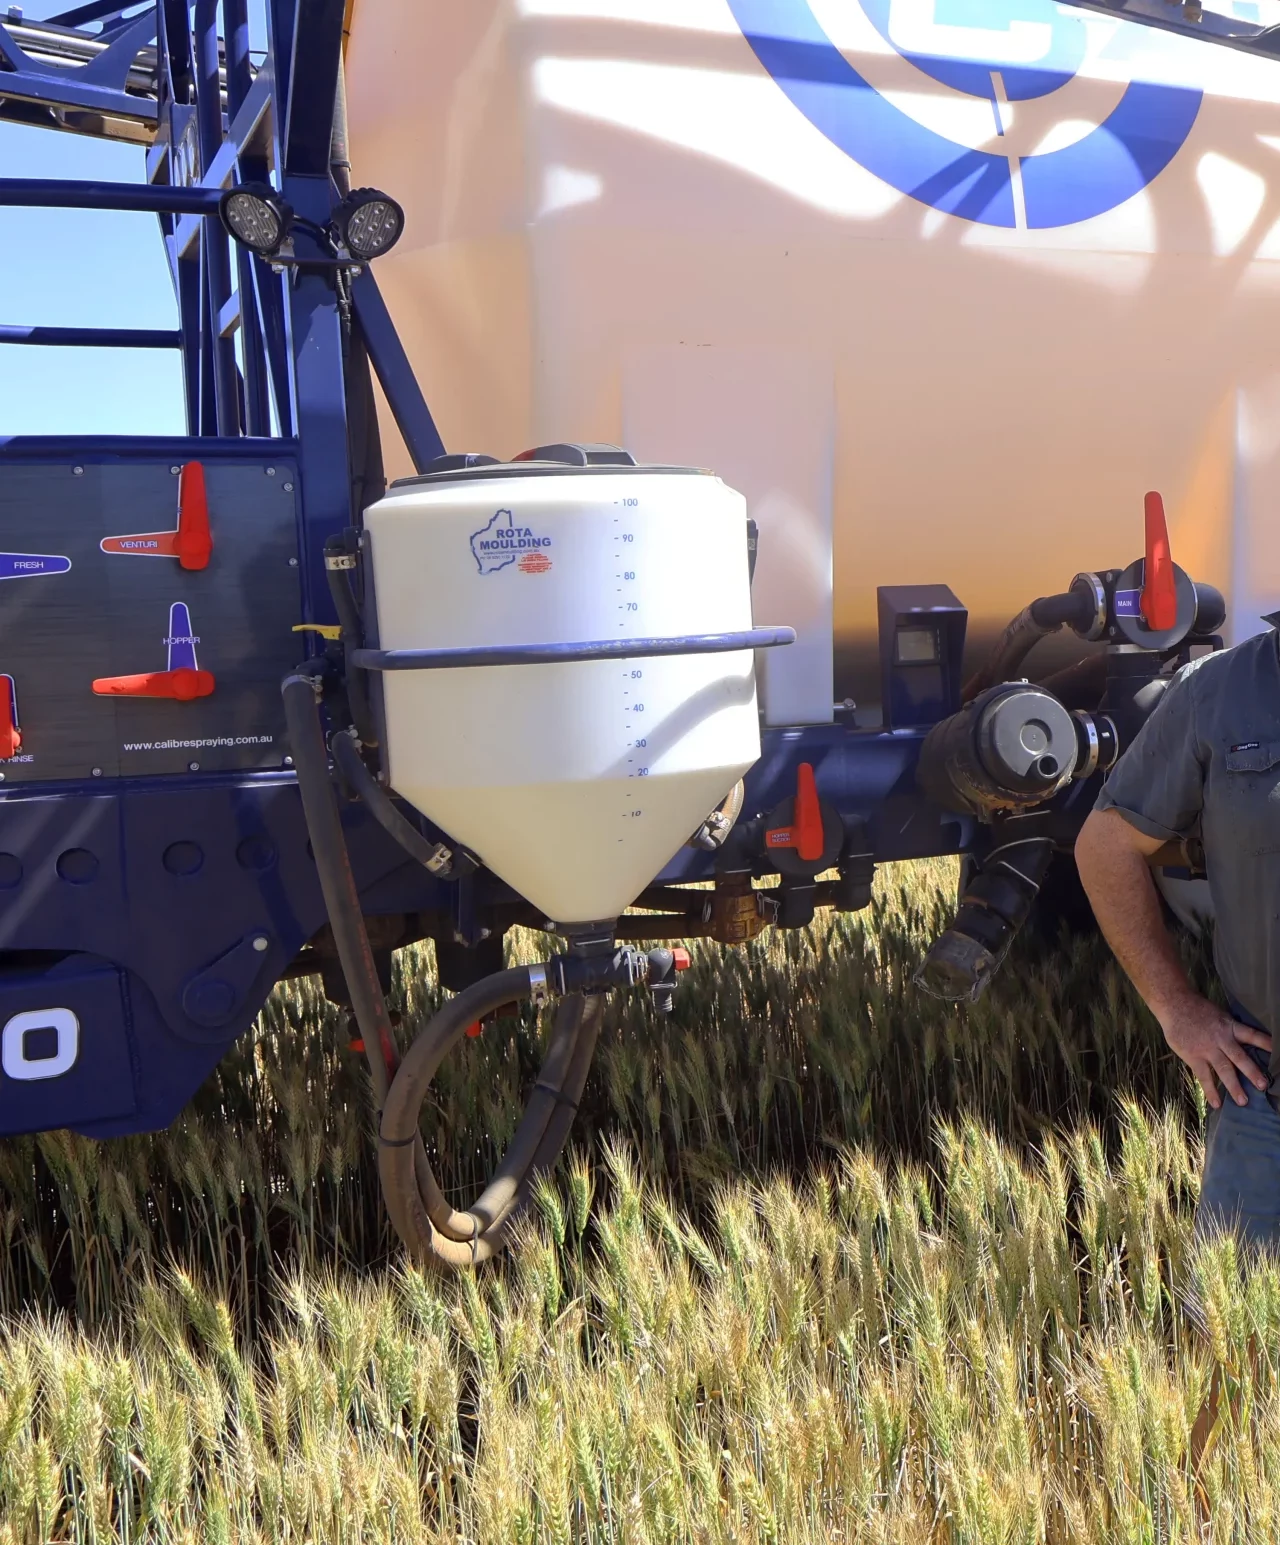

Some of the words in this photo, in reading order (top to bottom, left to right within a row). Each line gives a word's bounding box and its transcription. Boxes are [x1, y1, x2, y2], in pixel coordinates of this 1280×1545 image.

[622, 498, 638, 507] 100
[496, 528, 533, 539] ROTA
[622, 534, 634, 542] 90
[120, 540, 158, 548] VENTURI
[480, 537, 552, 550] MOULDING
[14, 561, 44, 569] FRESH
[624, 571, 635, 580] 80
[626, 602, 638, 611] 70
[162, 636, 201, 645] HOPPER
[631, 670, 642, 679] 50
[633, 703, 645, 712] 40
[124, 735, 273, 751] www.calibrespraying.com.au
[635, 738, 647, 747] 30
[638, 767, 649, 776] 20
